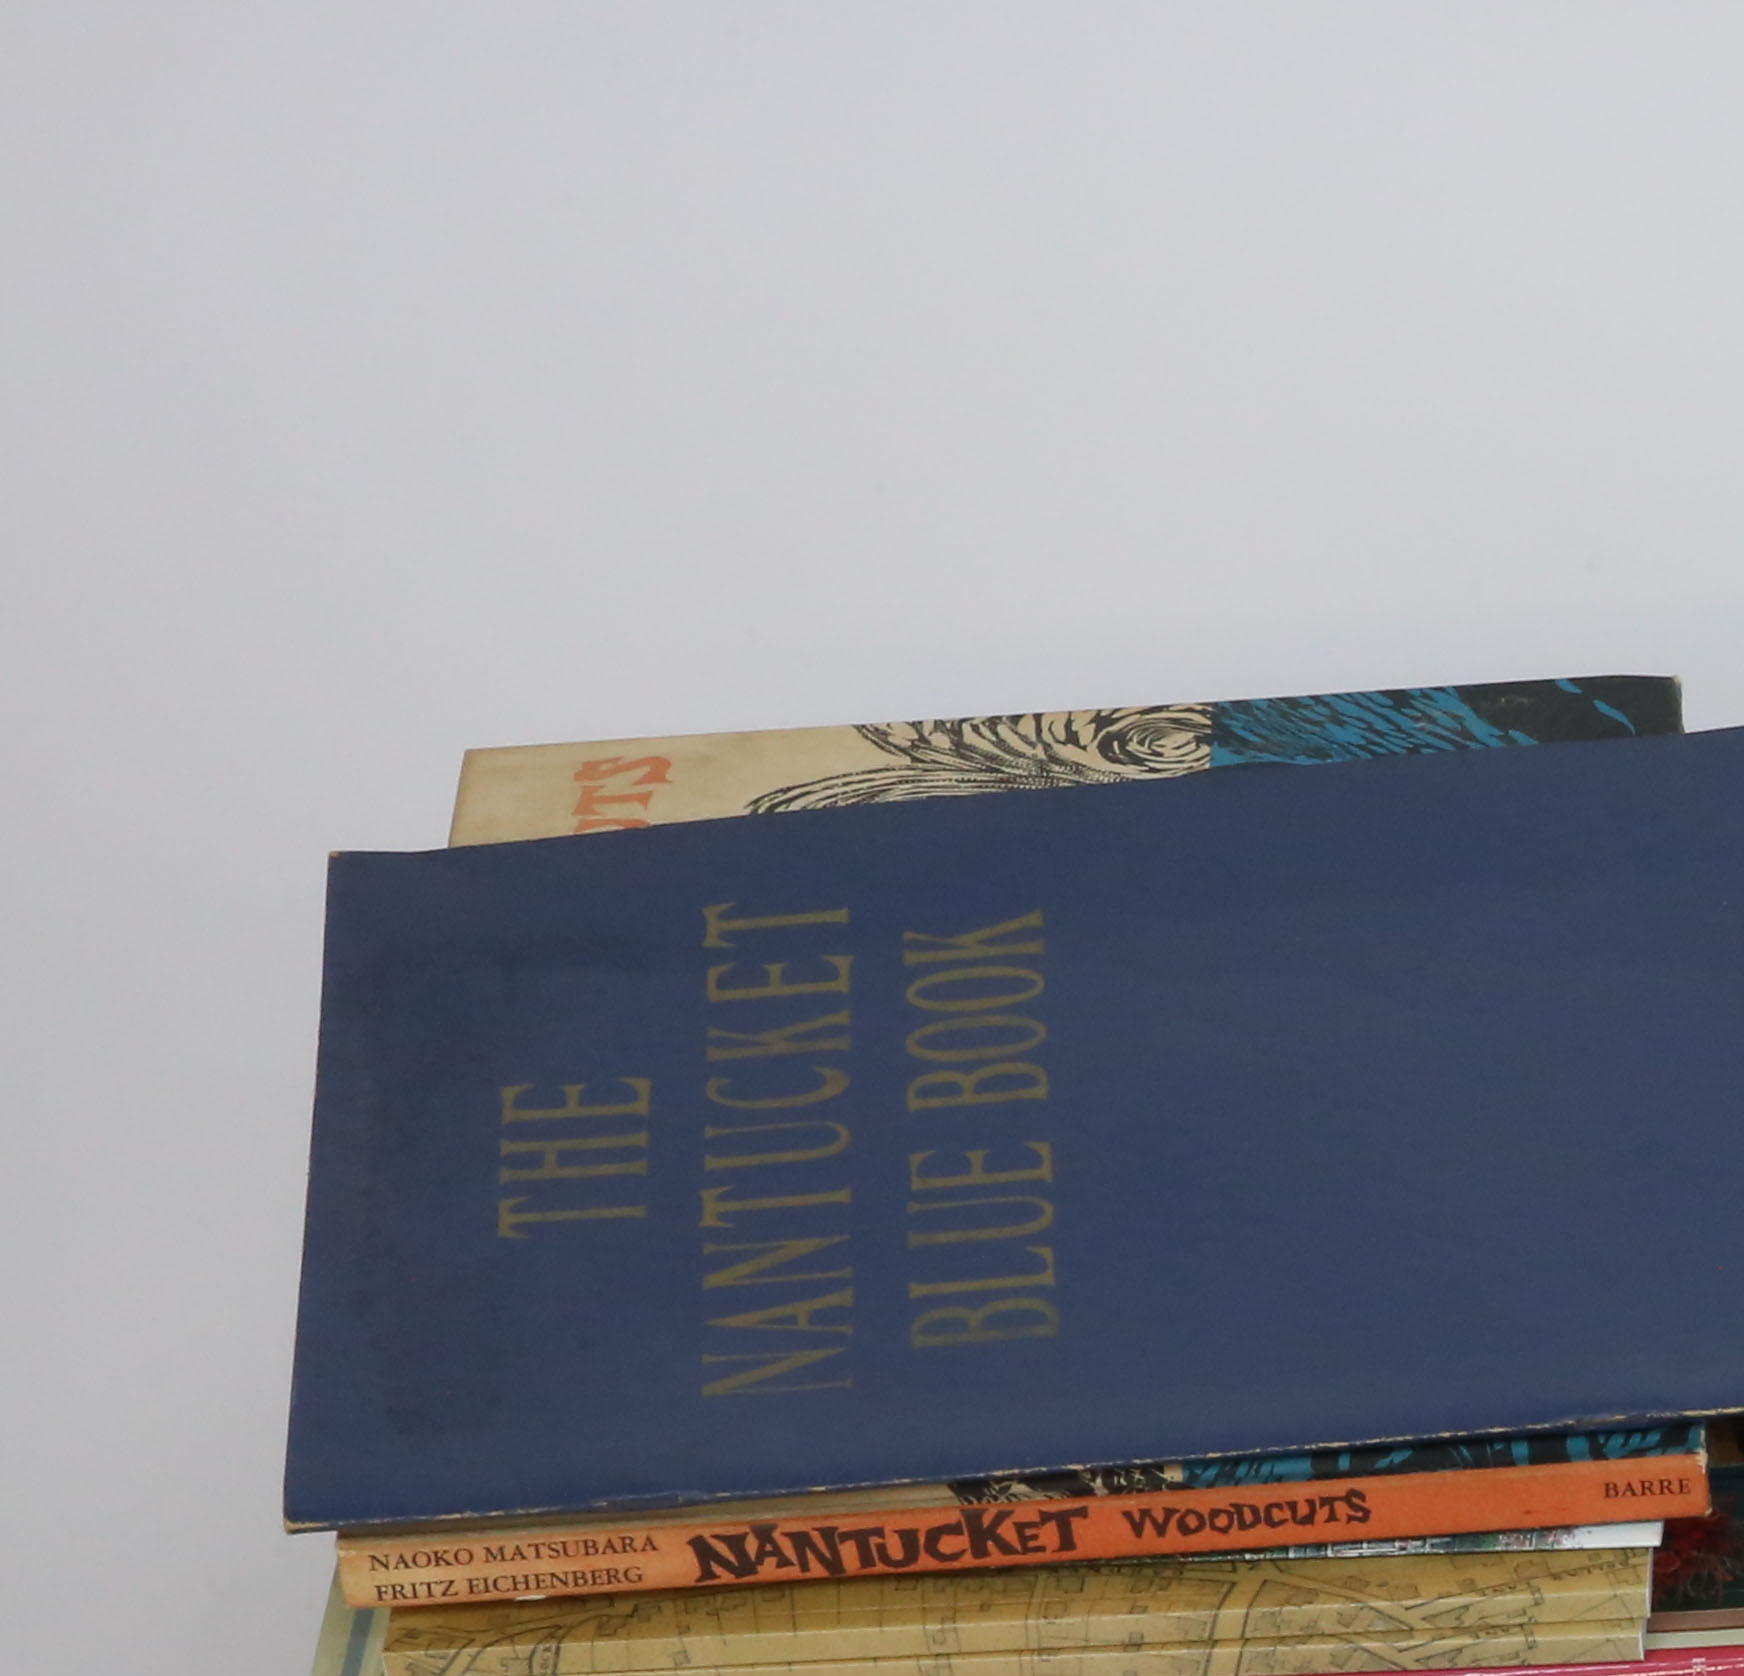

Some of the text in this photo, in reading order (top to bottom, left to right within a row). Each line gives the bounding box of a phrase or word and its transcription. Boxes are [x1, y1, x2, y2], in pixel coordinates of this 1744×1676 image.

[496, 1076, 652, 1240] THE
[697, 903, 855, 1398] NANTUCKET
[902, 910, 1060, 1349] BLUE BOOK
[368, 1475, 1692, 1584] NAOKO MATSUBARA NANTUCKET WOODCUTS BARRE
[374, 1566, 645, 1603] FRITZ EICHENBERG
